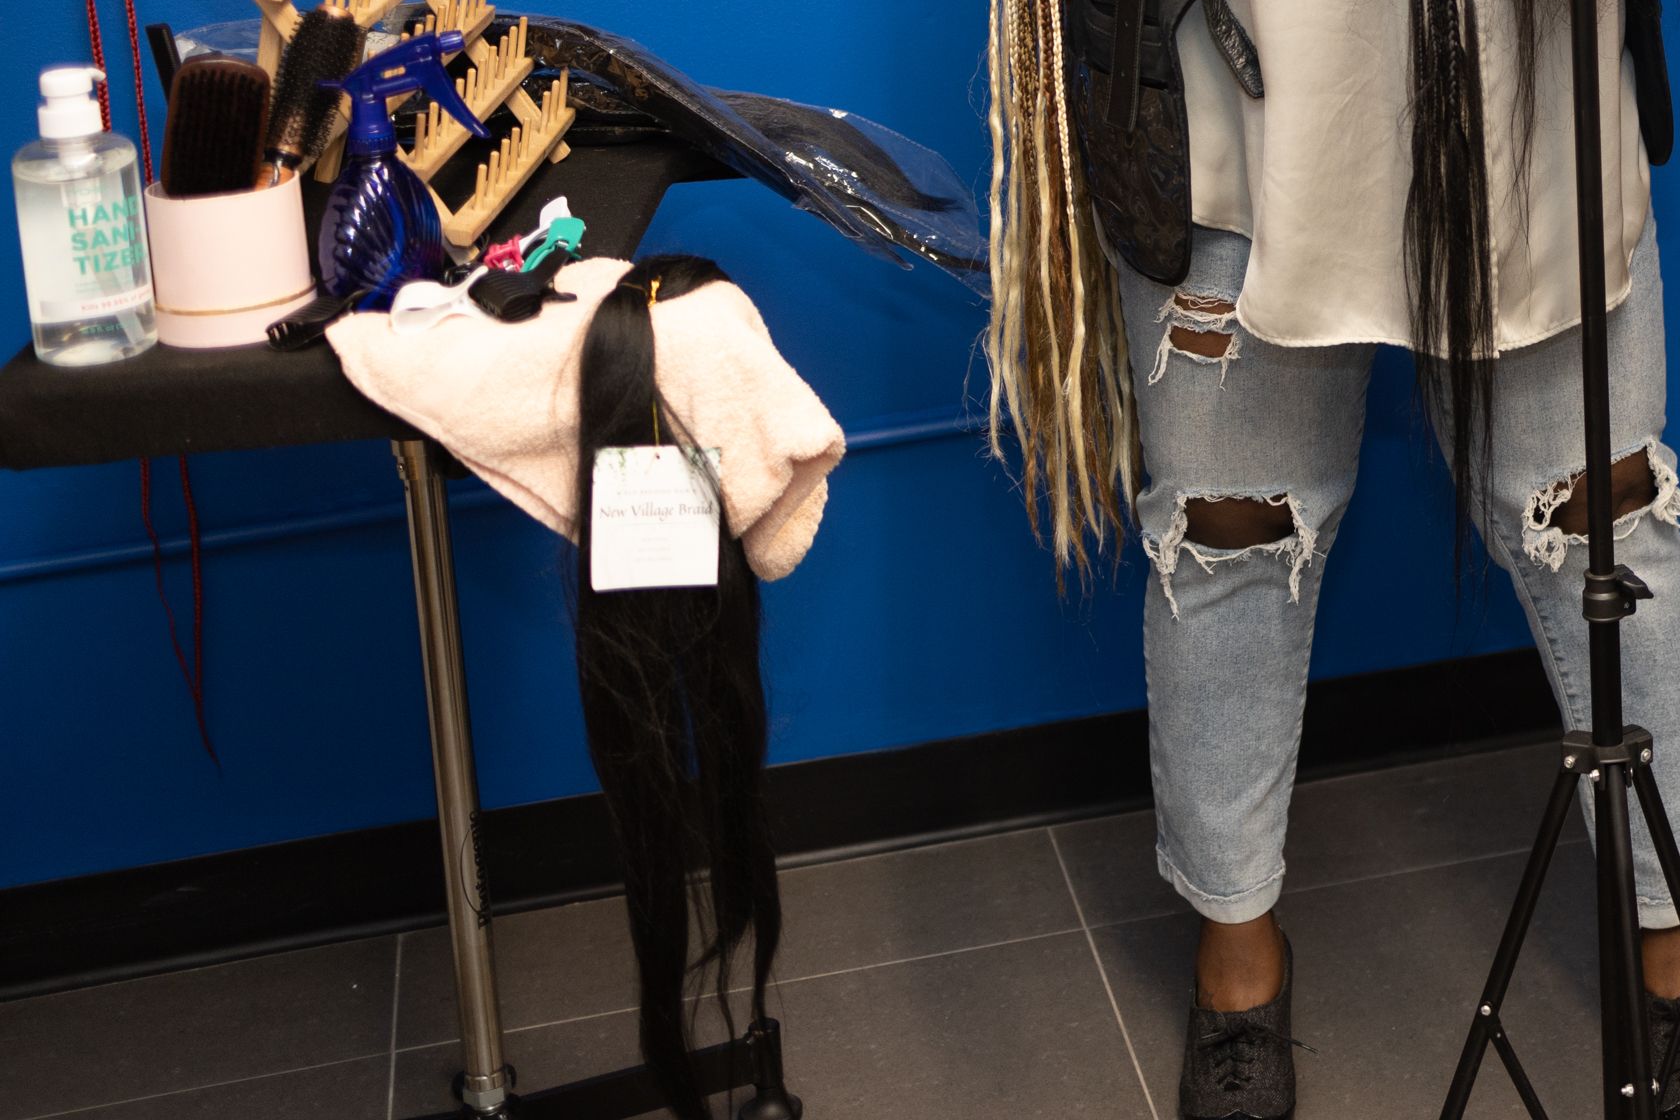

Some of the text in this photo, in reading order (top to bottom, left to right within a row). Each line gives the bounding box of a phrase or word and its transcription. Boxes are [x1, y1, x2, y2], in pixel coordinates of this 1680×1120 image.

[73, 243, 145, 275] TIZER
[600, 500, 713, 522] New Village Braid
